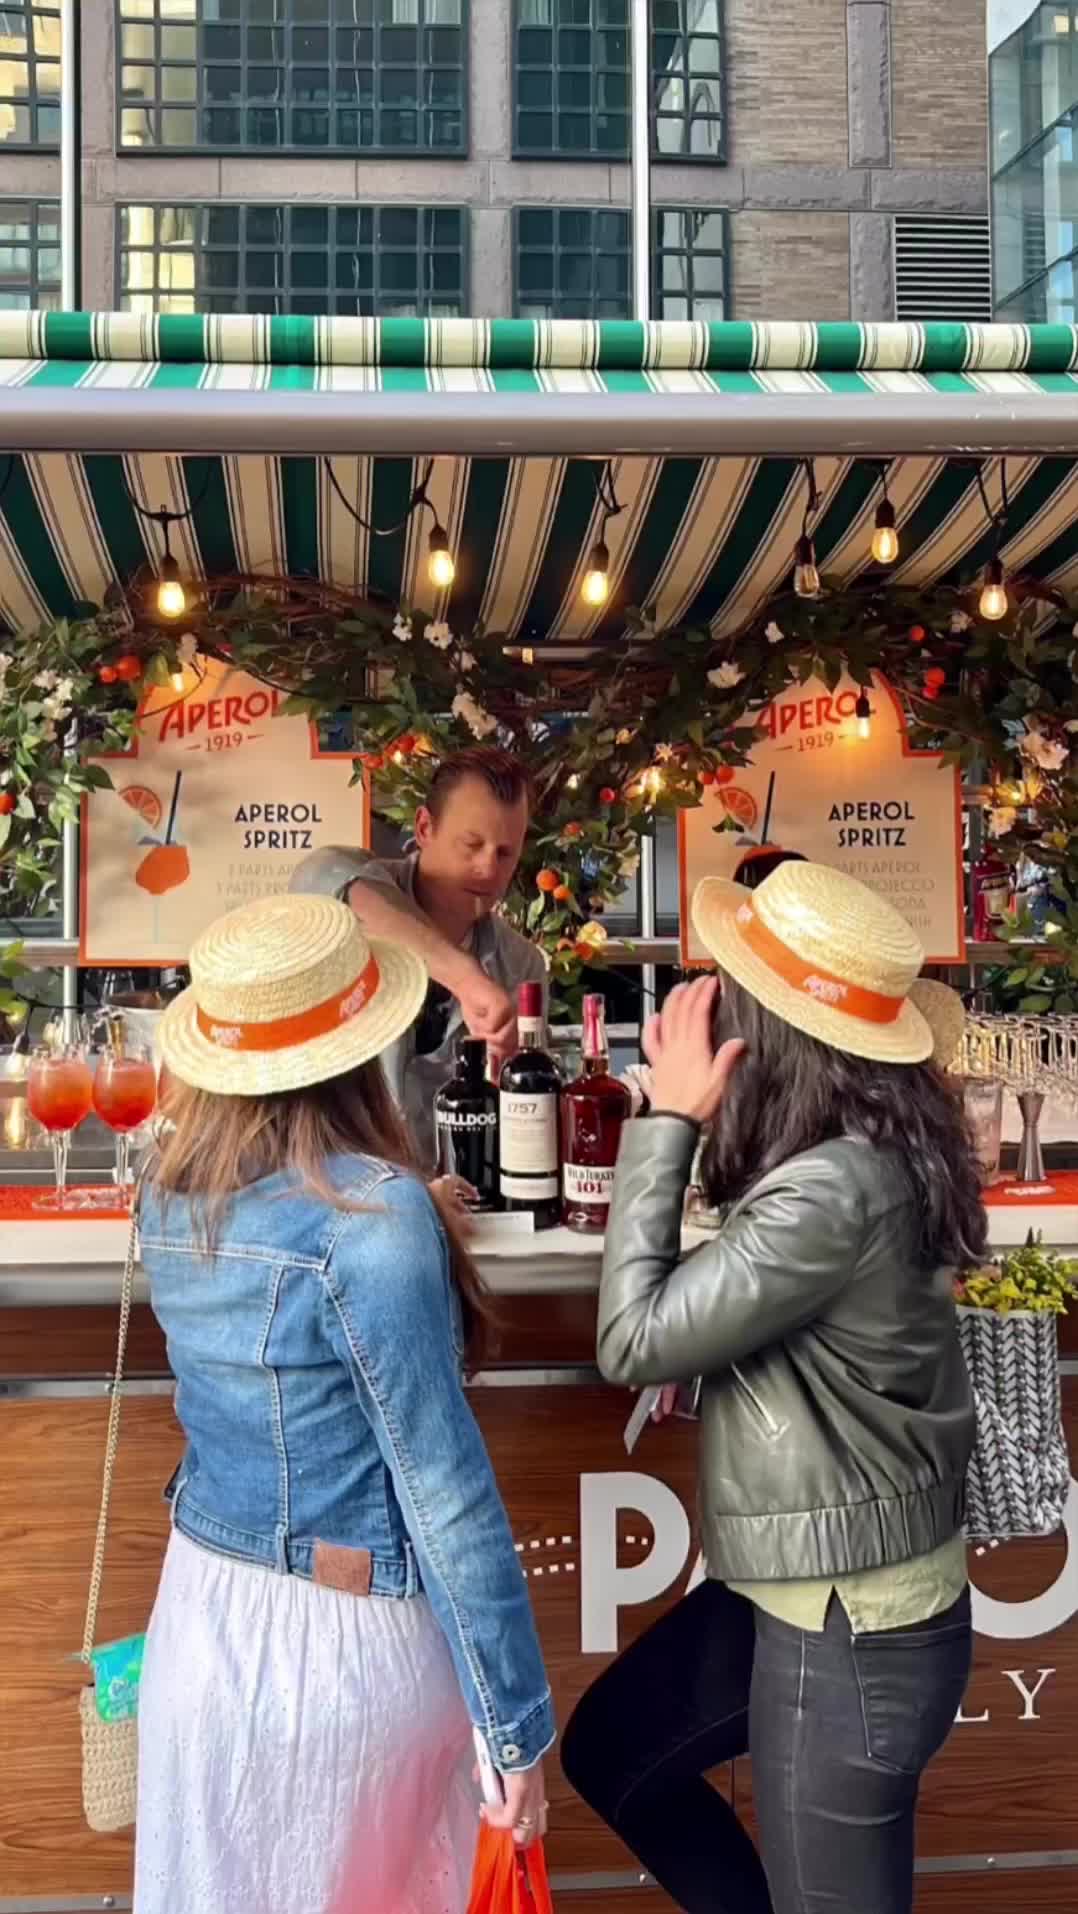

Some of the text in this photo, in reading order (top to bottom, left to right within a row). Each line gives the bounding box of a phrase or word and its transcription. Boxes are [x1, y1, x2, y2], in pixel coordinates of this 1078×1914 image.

[755, 691, 877, 739] APERO
[206, 731, 243, 752] 1919
[798, 731, 834, 752] 1919
[234, 803, 322, 823] APEROL
[828, 801, 915, 822] APEROL
[243, 830, 312, 849] SPRITZ
[837, 828, 906, 848] SPRITZ
[507, 1103, 538, 1114] 1757
[577, 1181, 603, 1194] 101
